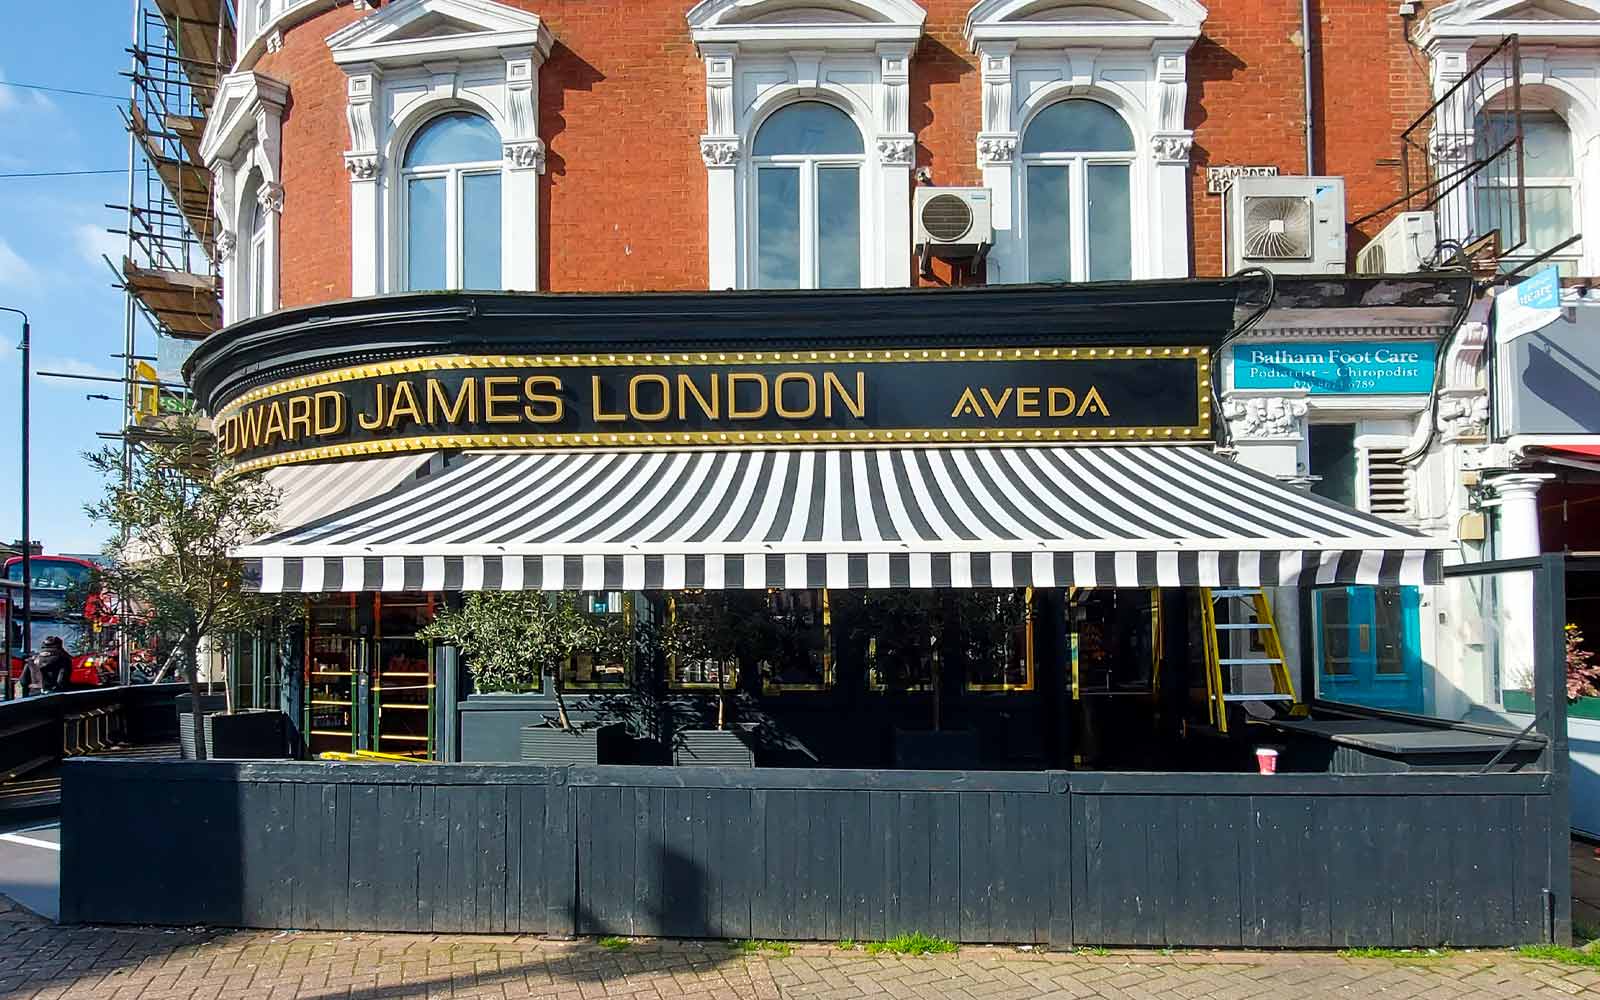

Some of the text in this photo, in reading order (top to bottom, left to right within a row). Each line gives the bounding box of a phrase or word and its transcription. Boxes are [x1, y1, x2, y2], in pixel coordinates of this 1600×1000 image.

[1251, 349, 1419, 364] Balham Foot Care
[1250, 367, 1316, 378] Podiatrist
[1336, 367, 1419, 380] Chiropodist
[217, 371, 865, 455] EDWARD JAMES LONDON
[951, 385, 1111, 418] AVEDA
